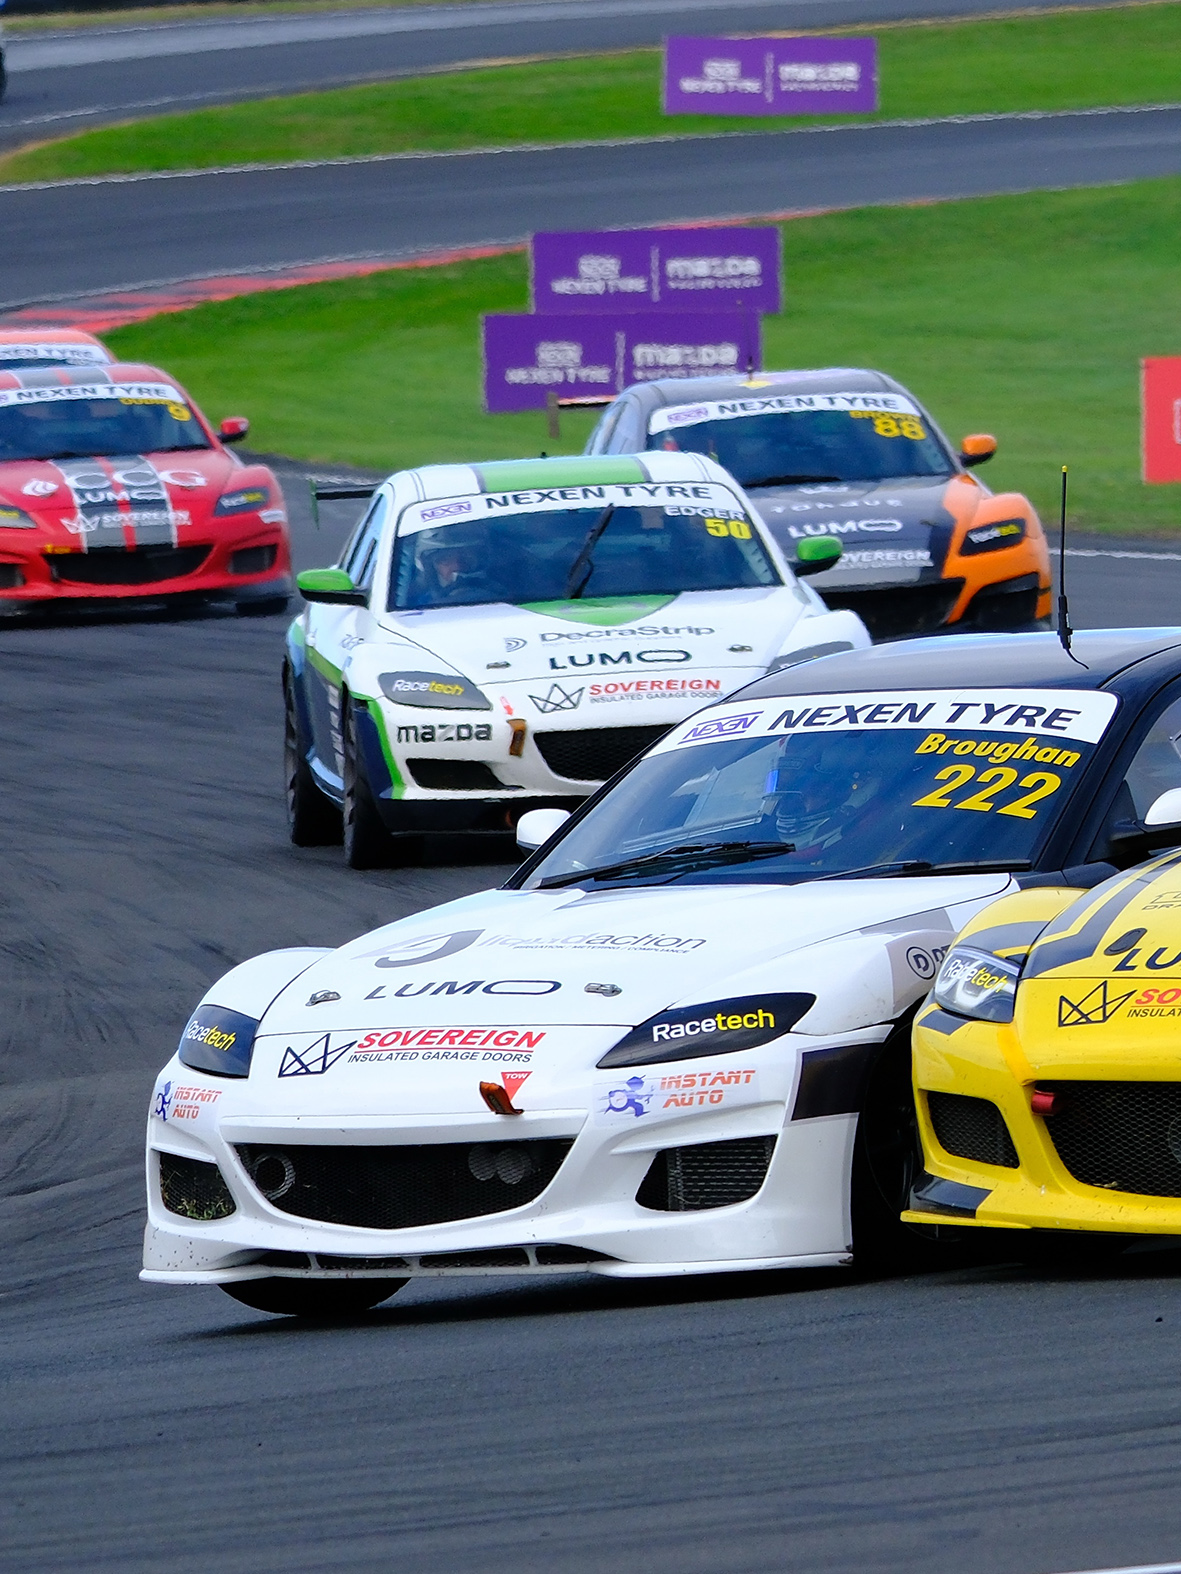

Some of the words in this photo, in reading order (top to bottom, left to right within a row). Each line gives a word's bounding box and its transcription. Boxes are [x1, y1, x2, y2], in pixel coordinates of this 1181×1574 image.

[17, 387, 97, 400] NEXEN
[104, 386, 168, 398] TYRE
[718, 397, 814, 414] NEXEN
[827, 397, 899, 409] TYRE
[874, 418, 926, 440] 88
[486, 487, 606, 509] NEXEN
[615, 486, 712, 500] TYRE
[665, 506, 745, 521] EDGER
[705, 518, 752, 540] 50
[787, 520, 903, 538] LUMO
[841, 551, 931, 564] OVEREIGN
[540, 626, 715, 642] DecraStrip
[550, 649, 692, 670] LUMO
[392, 679, 464, 696] Racetech
[589, 679, 721, 696] SOVEREIGN
[590, 693, 644, 704] INSULATED
[646, 691, 689, 700] GARAGE
[769, 702, 936, 730] NEXEN
[944, 702, 1082, 731] TYRE
[684, 713, 761, 741] NEXEN
[914, 733, 1081, 768] Broughan
[911, 763, 1062, 820] 222
[944, 960, 1008, 993] Racetech
[364, 979, 562, 1000] LUMO
[652, 1008, 775, 1042] Racetech
[357, 1029, 547, 1048] SOVEREIGN
[347, 1051, 419, 1064] INSULATED
[421, 1051, 480, 1061] GARAGE
[481, 1052, 532, 1063] DOORS
[659, 1070, 756, 1090] INSTANT
[174, 1086, 222, 1103] INSTANT
[662, 1089, 724, 1109] AUTO
[172, 1104, 200, 1119] AUTO
